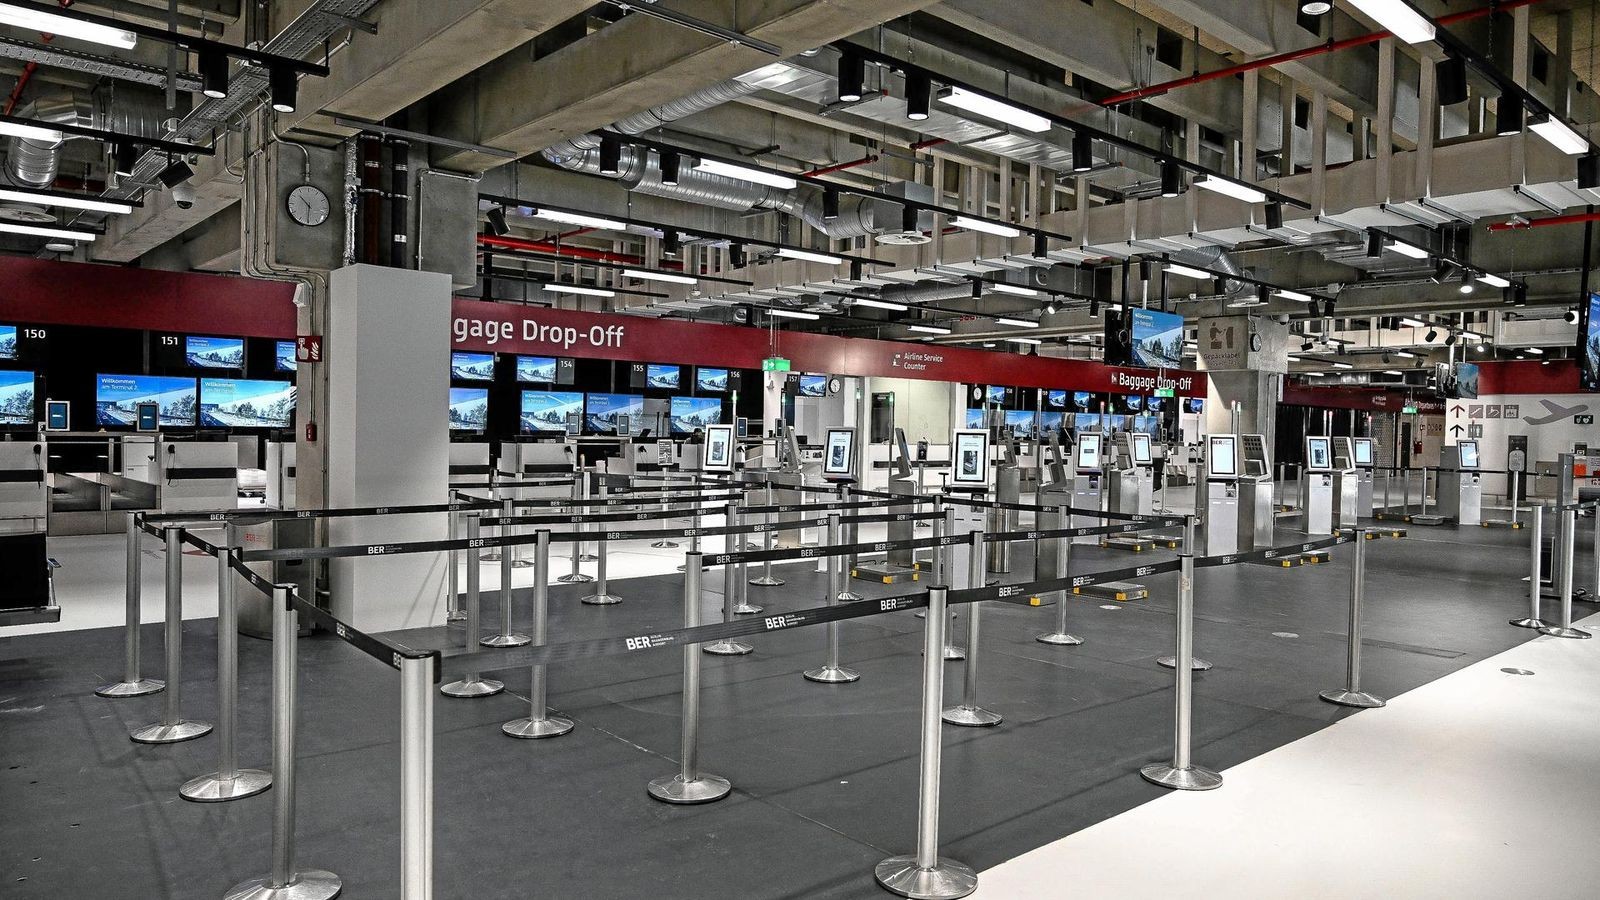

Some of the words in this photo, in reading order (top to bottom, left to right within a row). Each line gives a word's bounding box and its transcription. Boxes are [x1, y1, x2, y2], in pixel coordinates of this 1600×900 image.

[24, 329, 46, 339] 150
[454, 317, 514, 344] gage
[522, 319, 624, 350] Drop-Off
[161, 336, 178, 345] 151
[904, 352, 923, 361] Airline
[924, 354, 943, 362] Service
[1120, 372, 1154, 390] Baggage
[1157, 376, 1192, 390] Drop-Off
[368, 546, 385, 554] BER
[716, 556, 730, 564] BER
[1136, 567, 1147, 576] BER
[1073, 577, 1084, 587] BER
[998, 587, 1012, 597] BER
[880, 599, 897, 610] BER
[765, 616, 786, 629] BER
[336, 622, 346, 638] BER
[626, 636, 651, 650] BER
